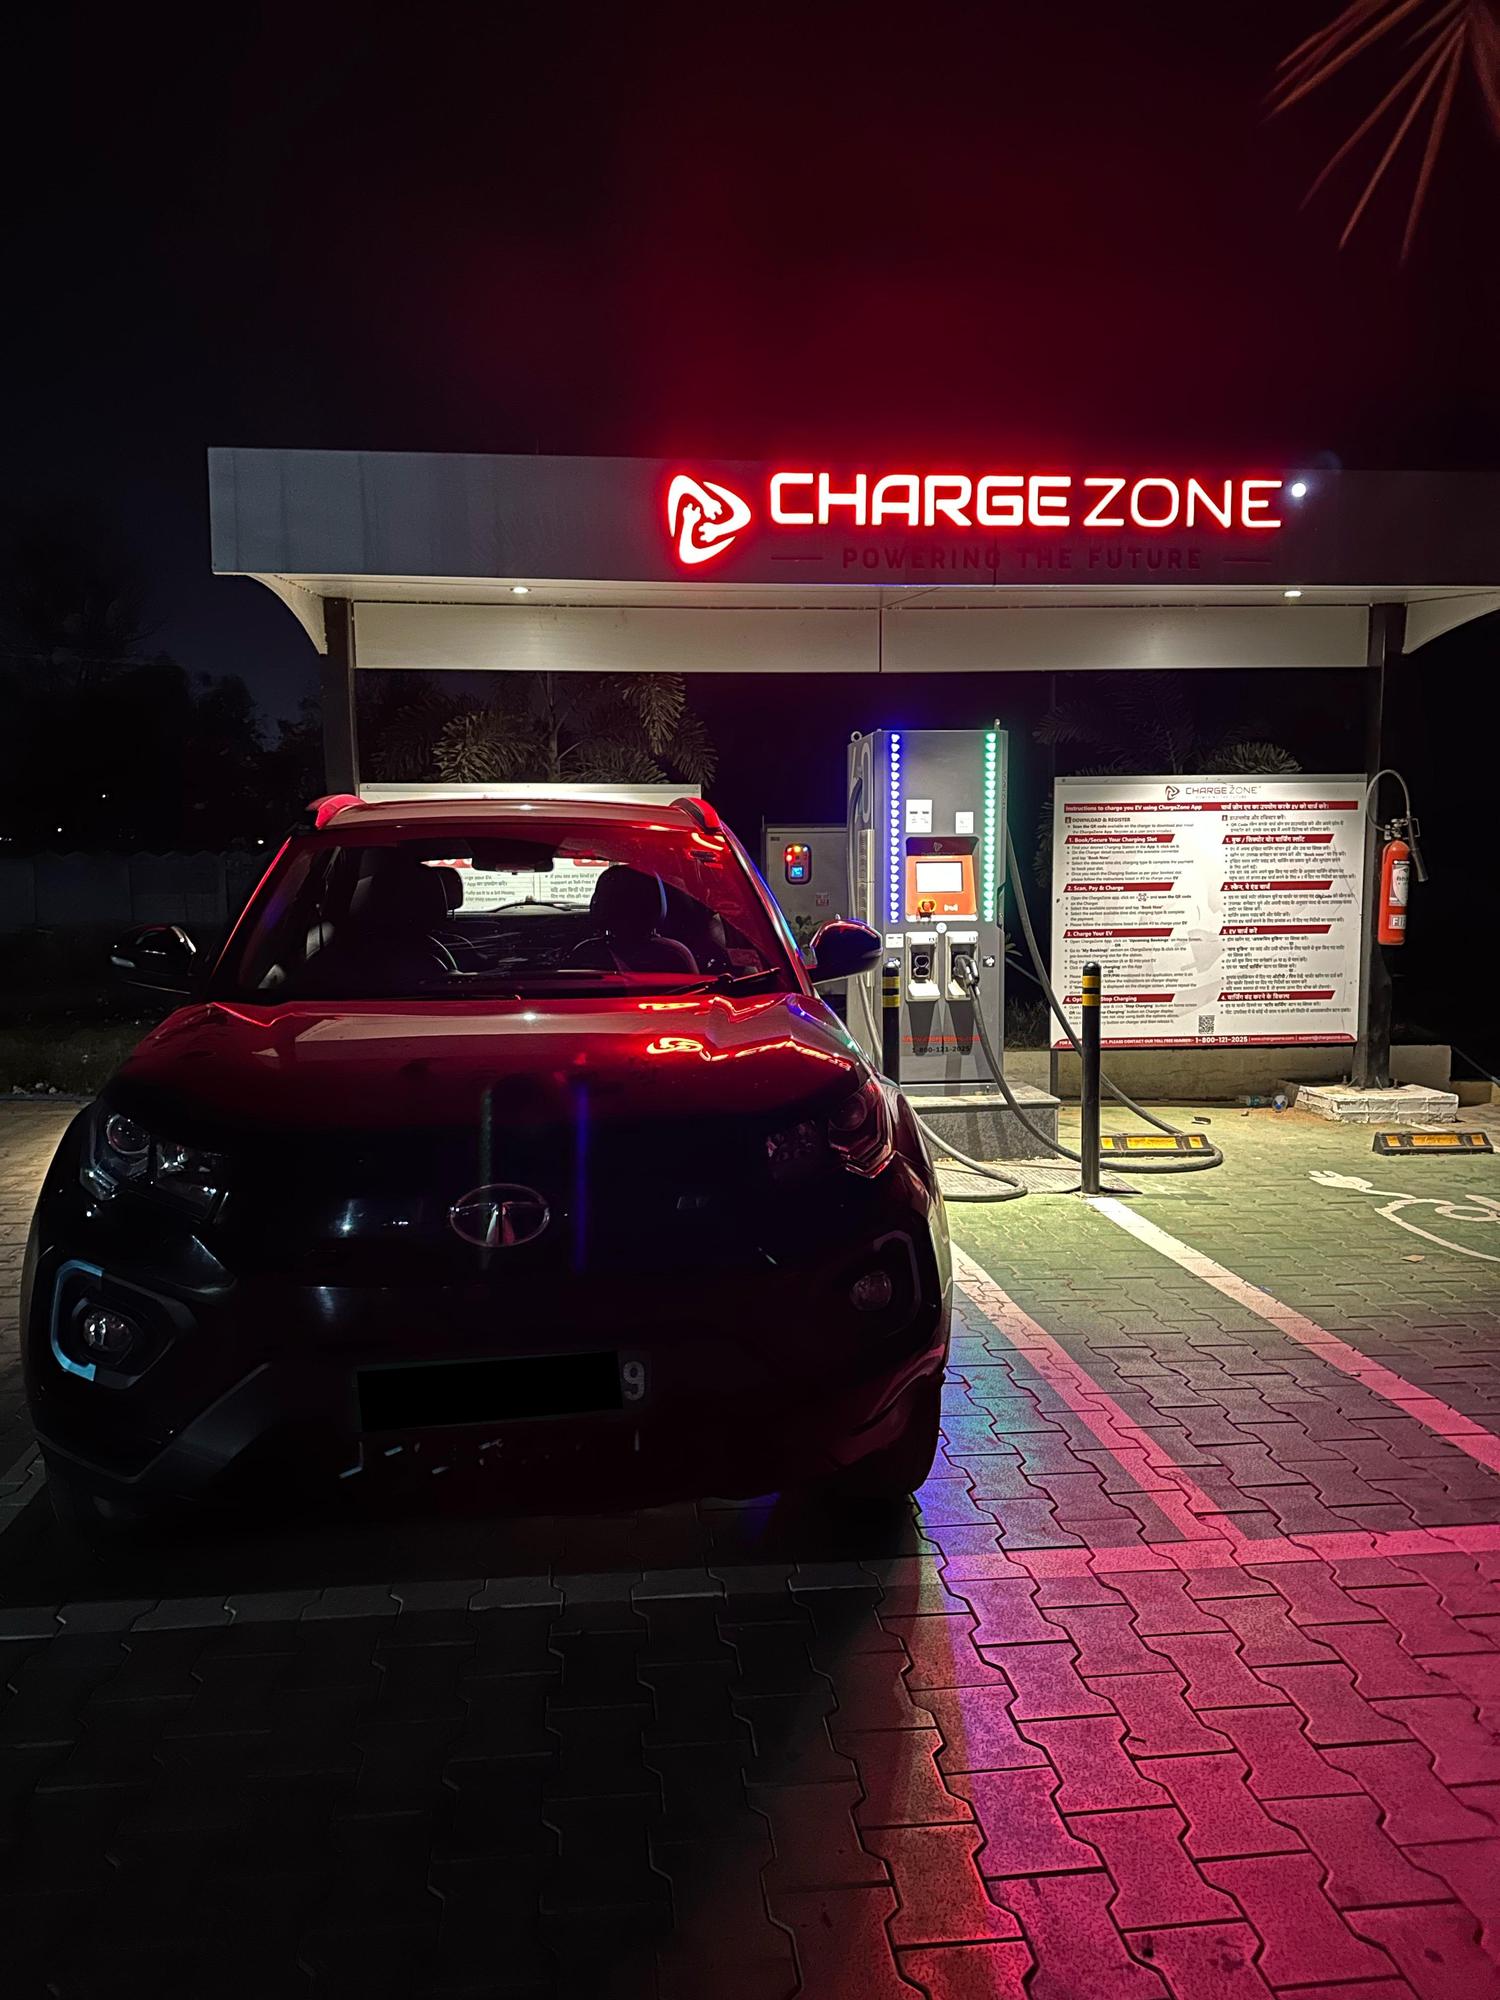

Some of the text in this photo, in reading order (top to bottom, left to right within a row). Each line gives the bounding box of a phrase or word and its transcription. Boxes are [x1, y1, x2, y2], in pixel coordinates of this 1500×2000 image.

[771, 473, 1281, 527] CHARGE ZONE
[843, 549, 1201, 569] POWERING THE FUTURE
